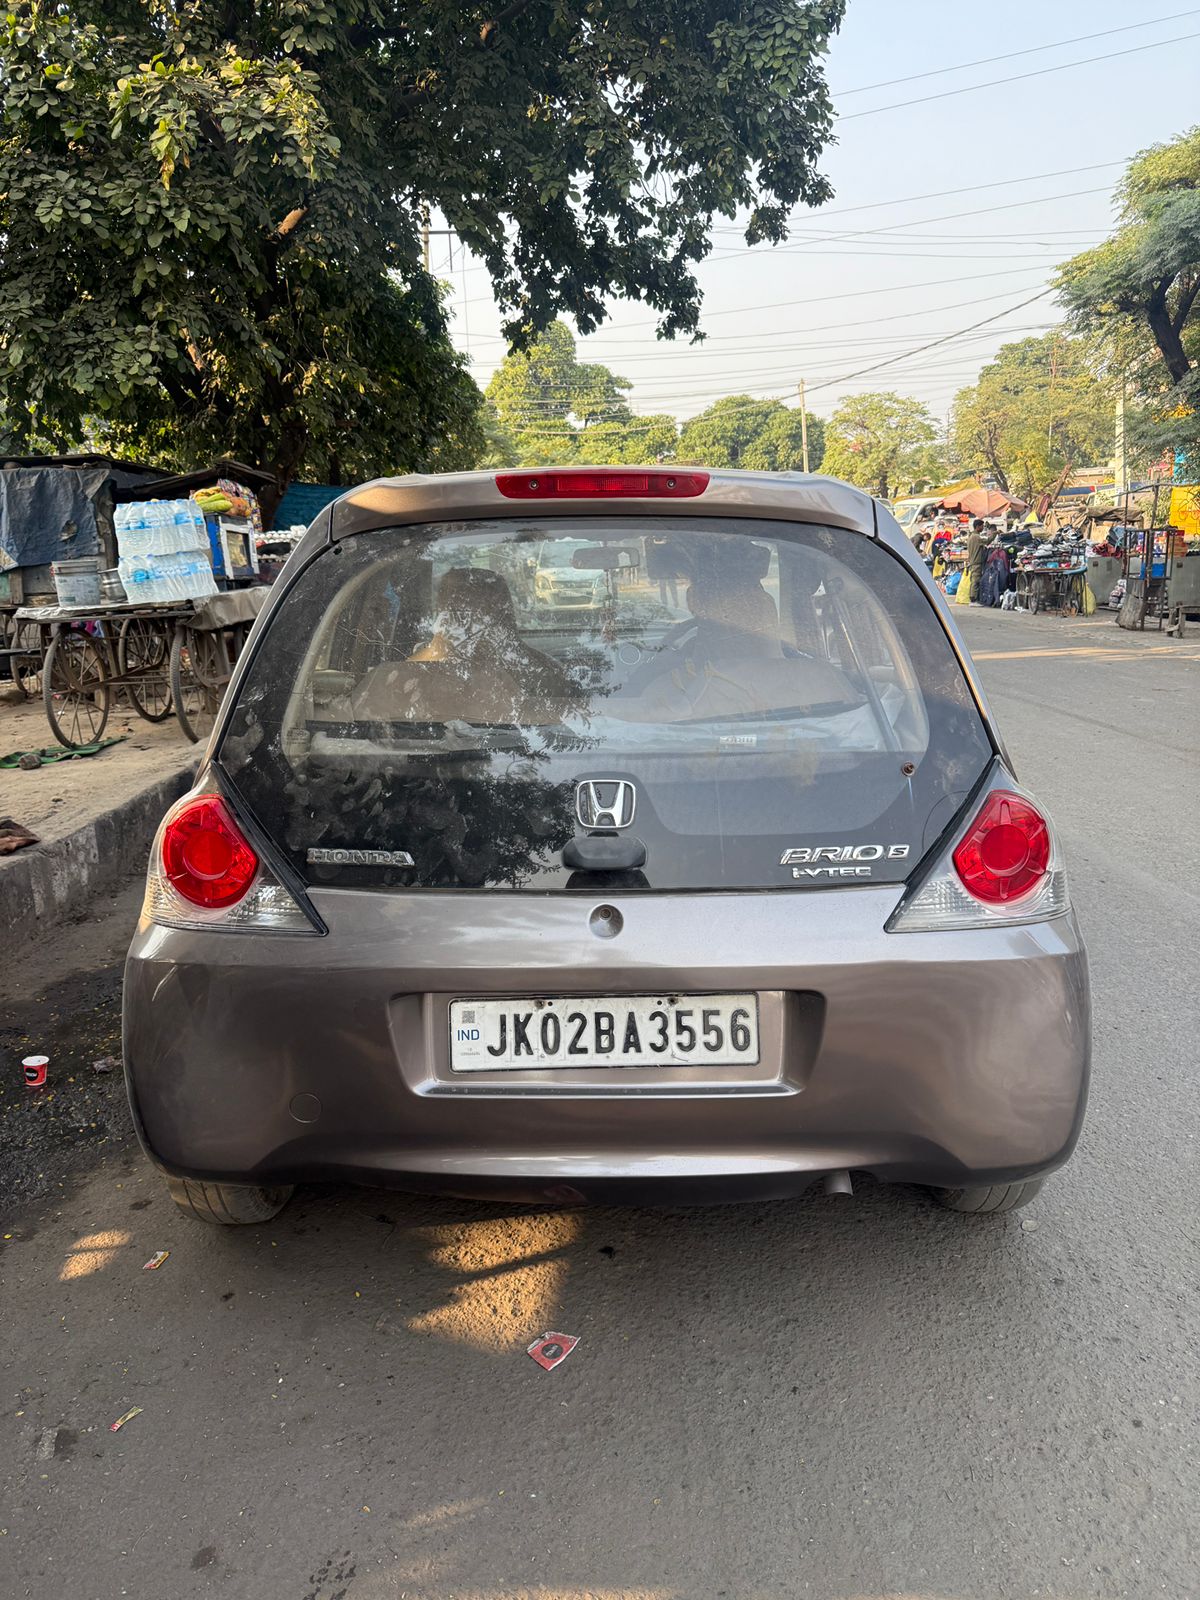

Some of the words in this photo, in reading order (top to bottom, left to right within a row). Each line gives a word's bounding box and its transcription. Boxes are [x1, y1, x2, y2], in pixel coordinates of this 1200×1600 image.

[306, 847, 415, 866] HONDA
[780, 845, 884, 864] BRIO
[888, 844, 909, 859] S
[457, 1029, 480, 1041] IND
[486, 1008, 751, 1057] JK02BA3556
